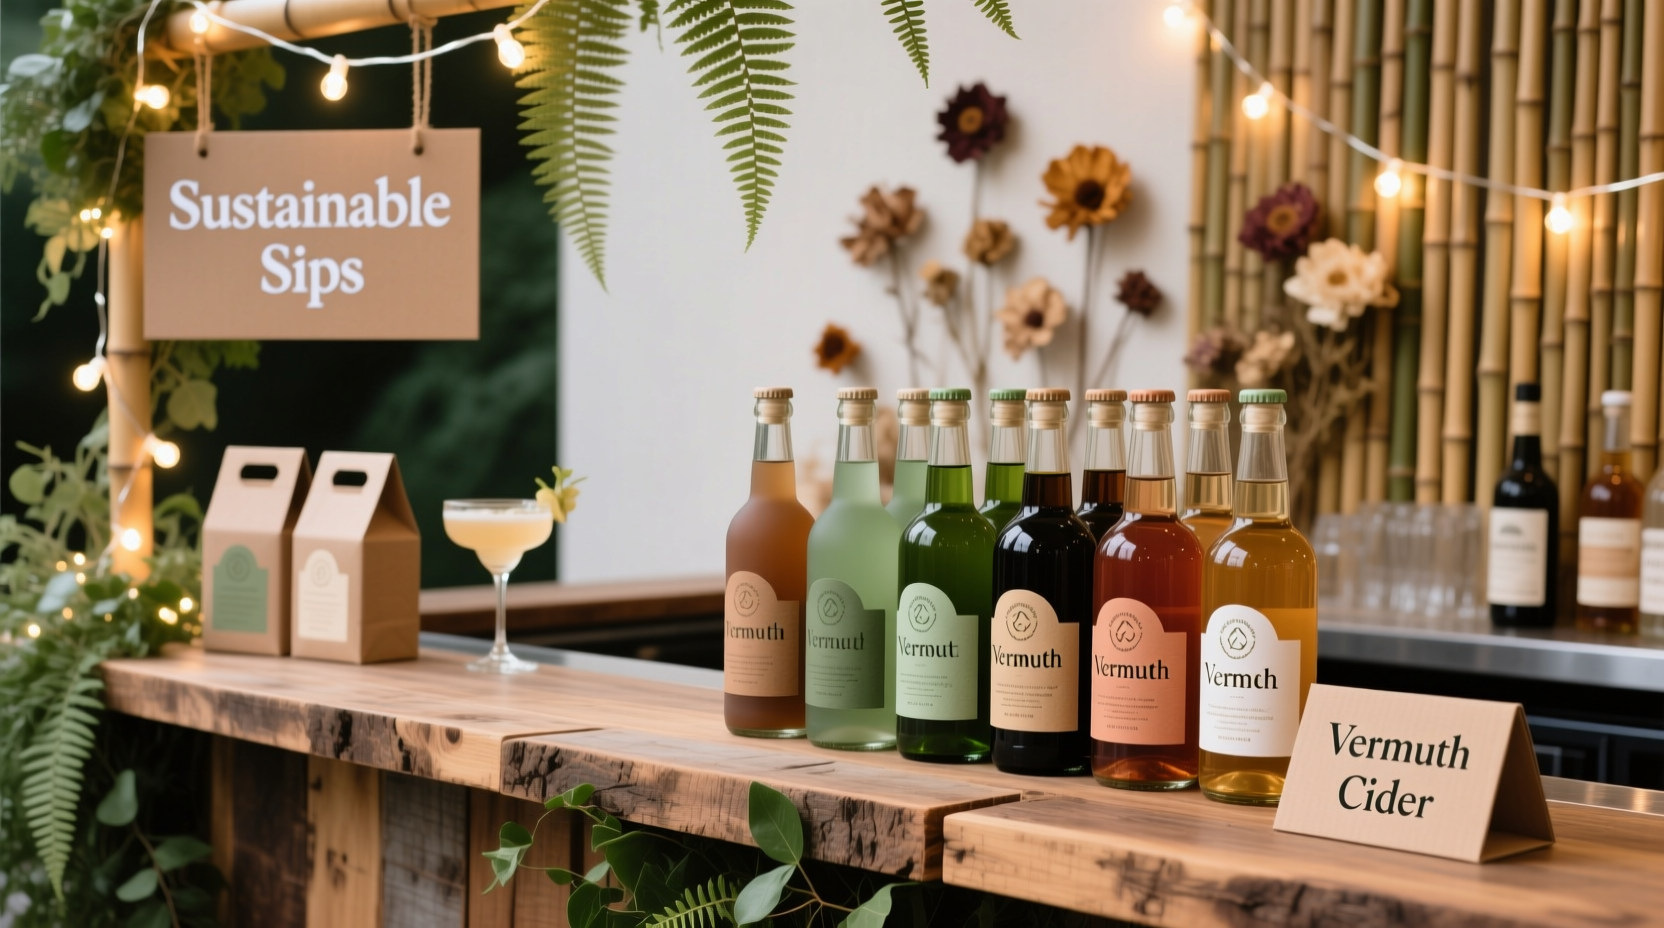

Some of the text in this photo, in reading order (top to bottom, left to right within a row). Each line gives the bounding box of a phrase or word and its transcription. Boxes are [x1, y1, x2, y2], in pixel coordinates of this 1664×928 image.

[169, 176, 451, 230] Sustainable
[260, 243, 364, 308] Sips
[992, 644, 1062, 668] Vermuth
[1094, 655, 1169, 680] Vermuth
[1329, 722, 1470, 770] Vermuth
[1338, 775, 1434, 818] Cider
